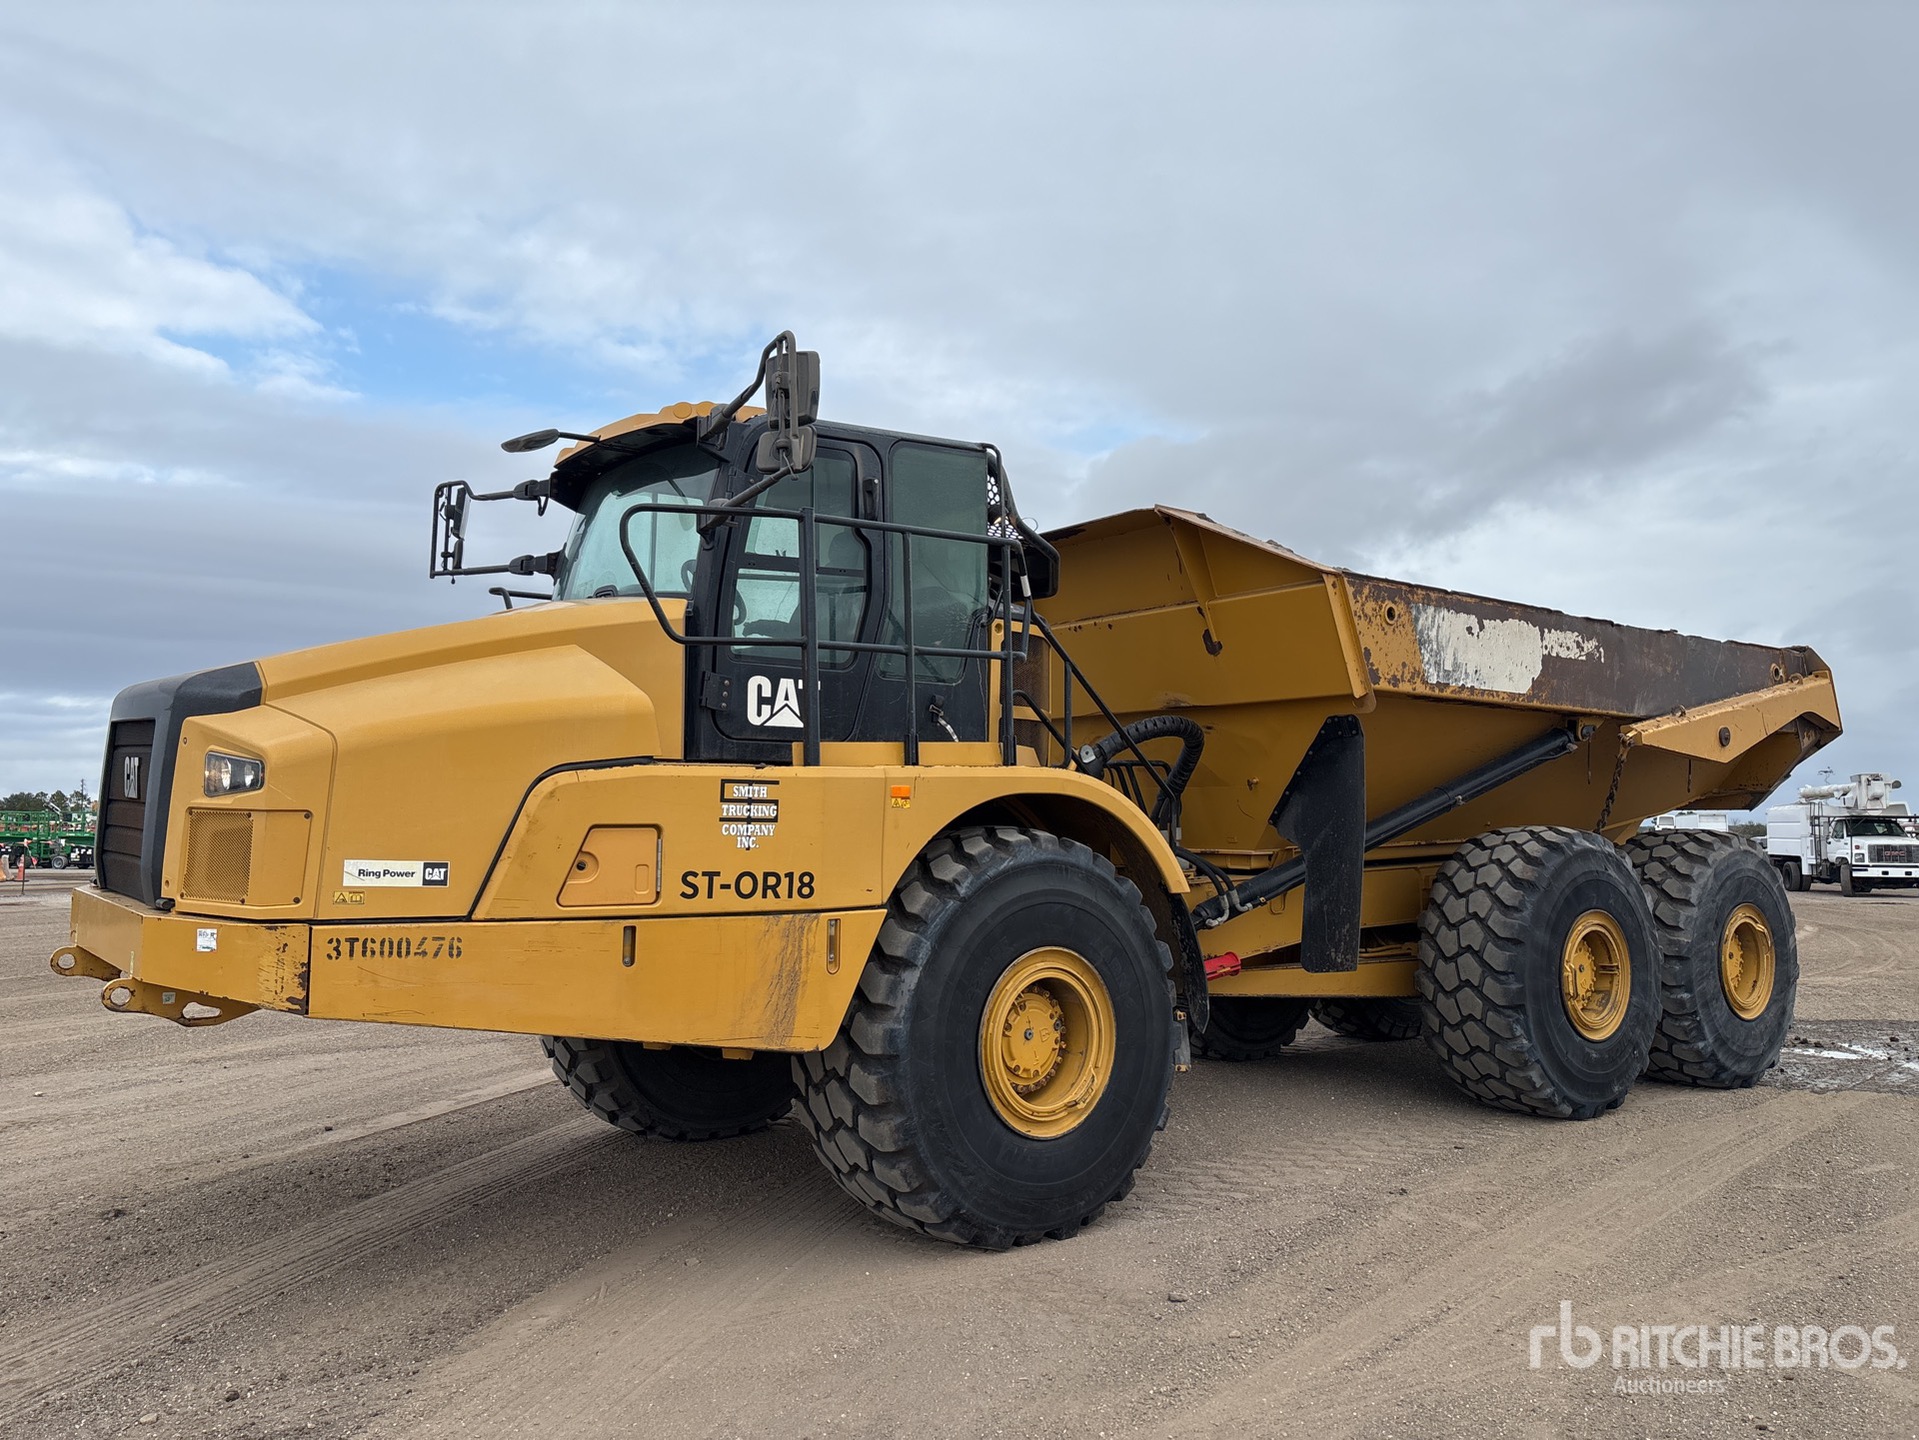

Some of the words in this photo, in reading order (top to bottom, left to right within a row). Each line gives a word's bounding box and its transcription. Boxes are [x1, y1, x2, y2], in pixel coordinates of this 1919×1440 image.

[747, 675, 821, 728] CA
[124, 756, 139, 799] CAT
[733, 786, 768, 798] SMITH
[721, 804, 778, 817] TRUCKING
[721, 824, 776, 836] COMPANY
[736, 836, 760, 849] INC.
[358, 869, 381, 879] Ring
[382, 869, 416, 878] Power
[424, 867, 447, 881] CAT
[679, 870, 815, 900] ST-OR18
[326, 936, 463, 961] 3T600476
